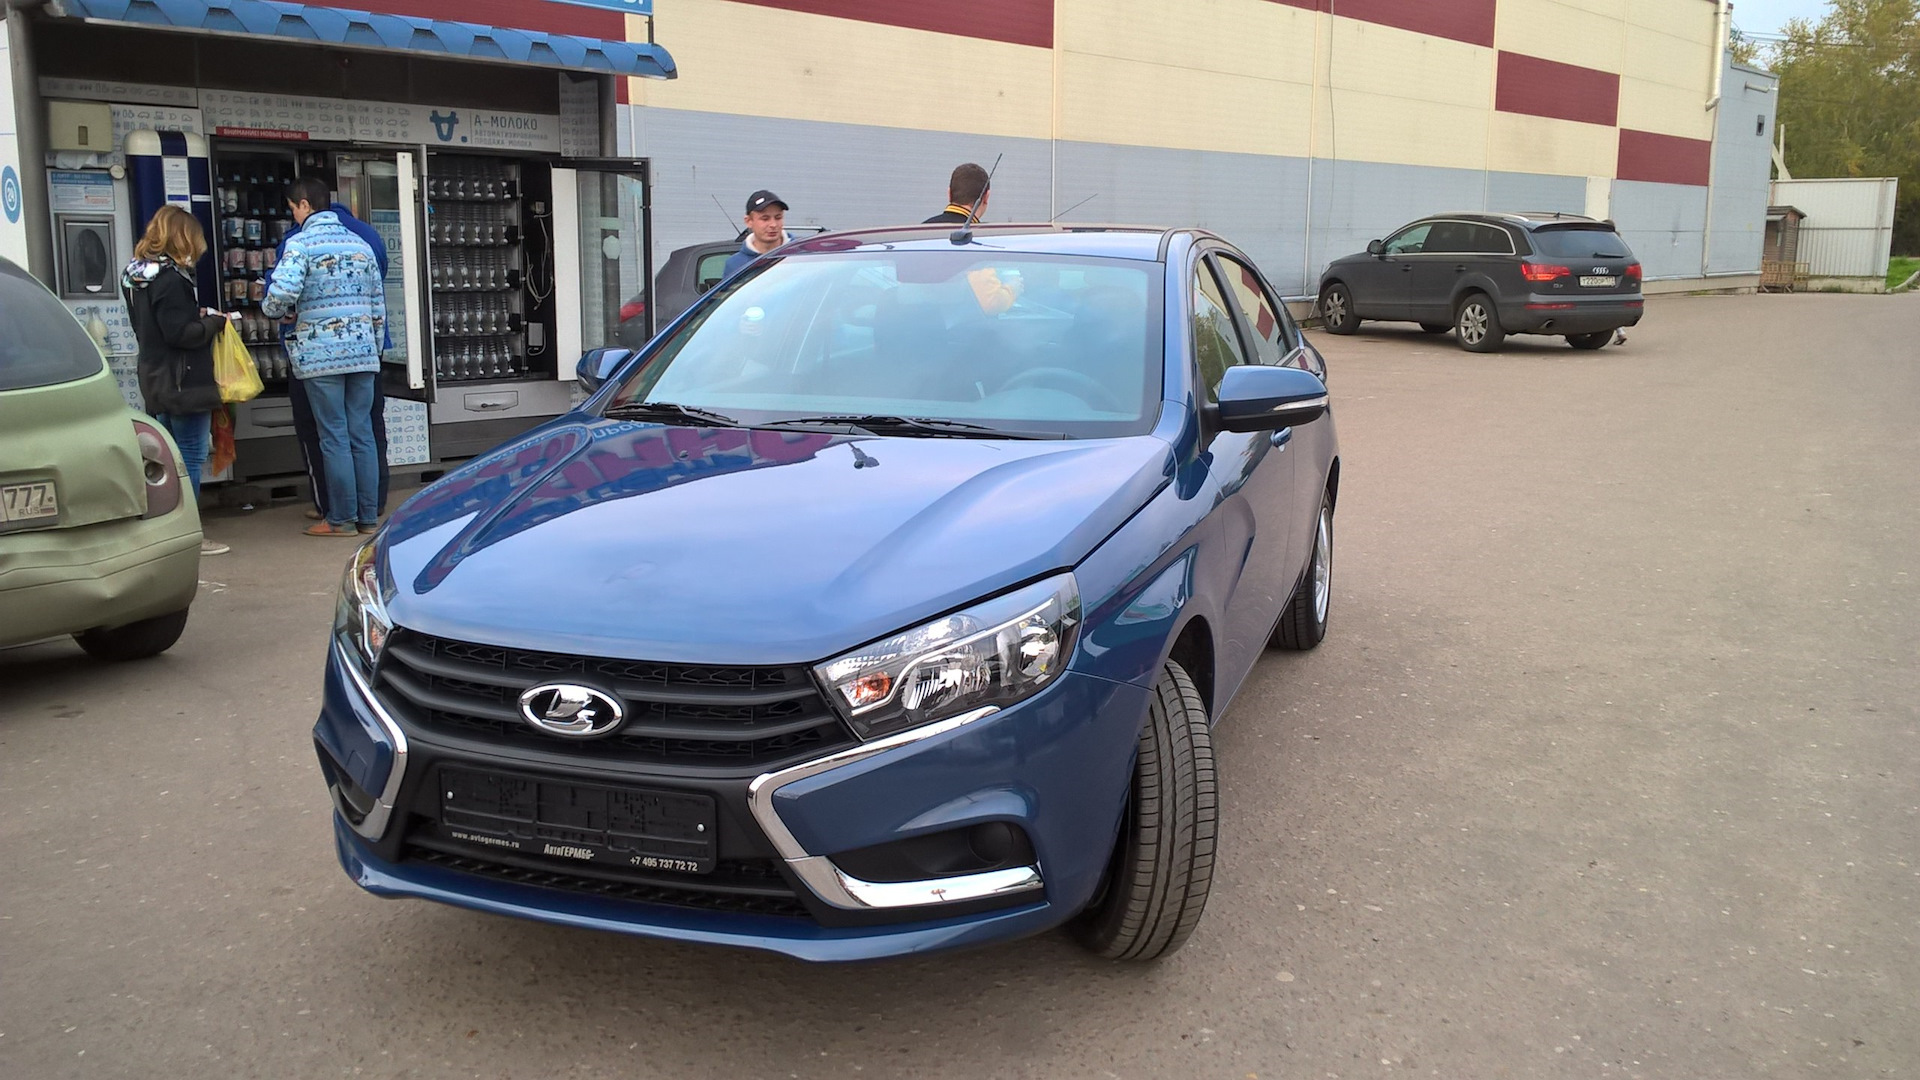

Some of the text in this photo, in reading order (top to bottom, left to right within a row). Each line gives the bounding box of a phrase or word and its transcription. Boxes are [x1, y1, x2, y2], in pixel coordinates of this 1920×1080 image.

[4, 485, 46, 509] 777
[19, 507, 40, 517] RUS
[451, 831, 520, 849] www.avtogermes.ru
[630, 855, 698, 872] +7 495 737 72 72
